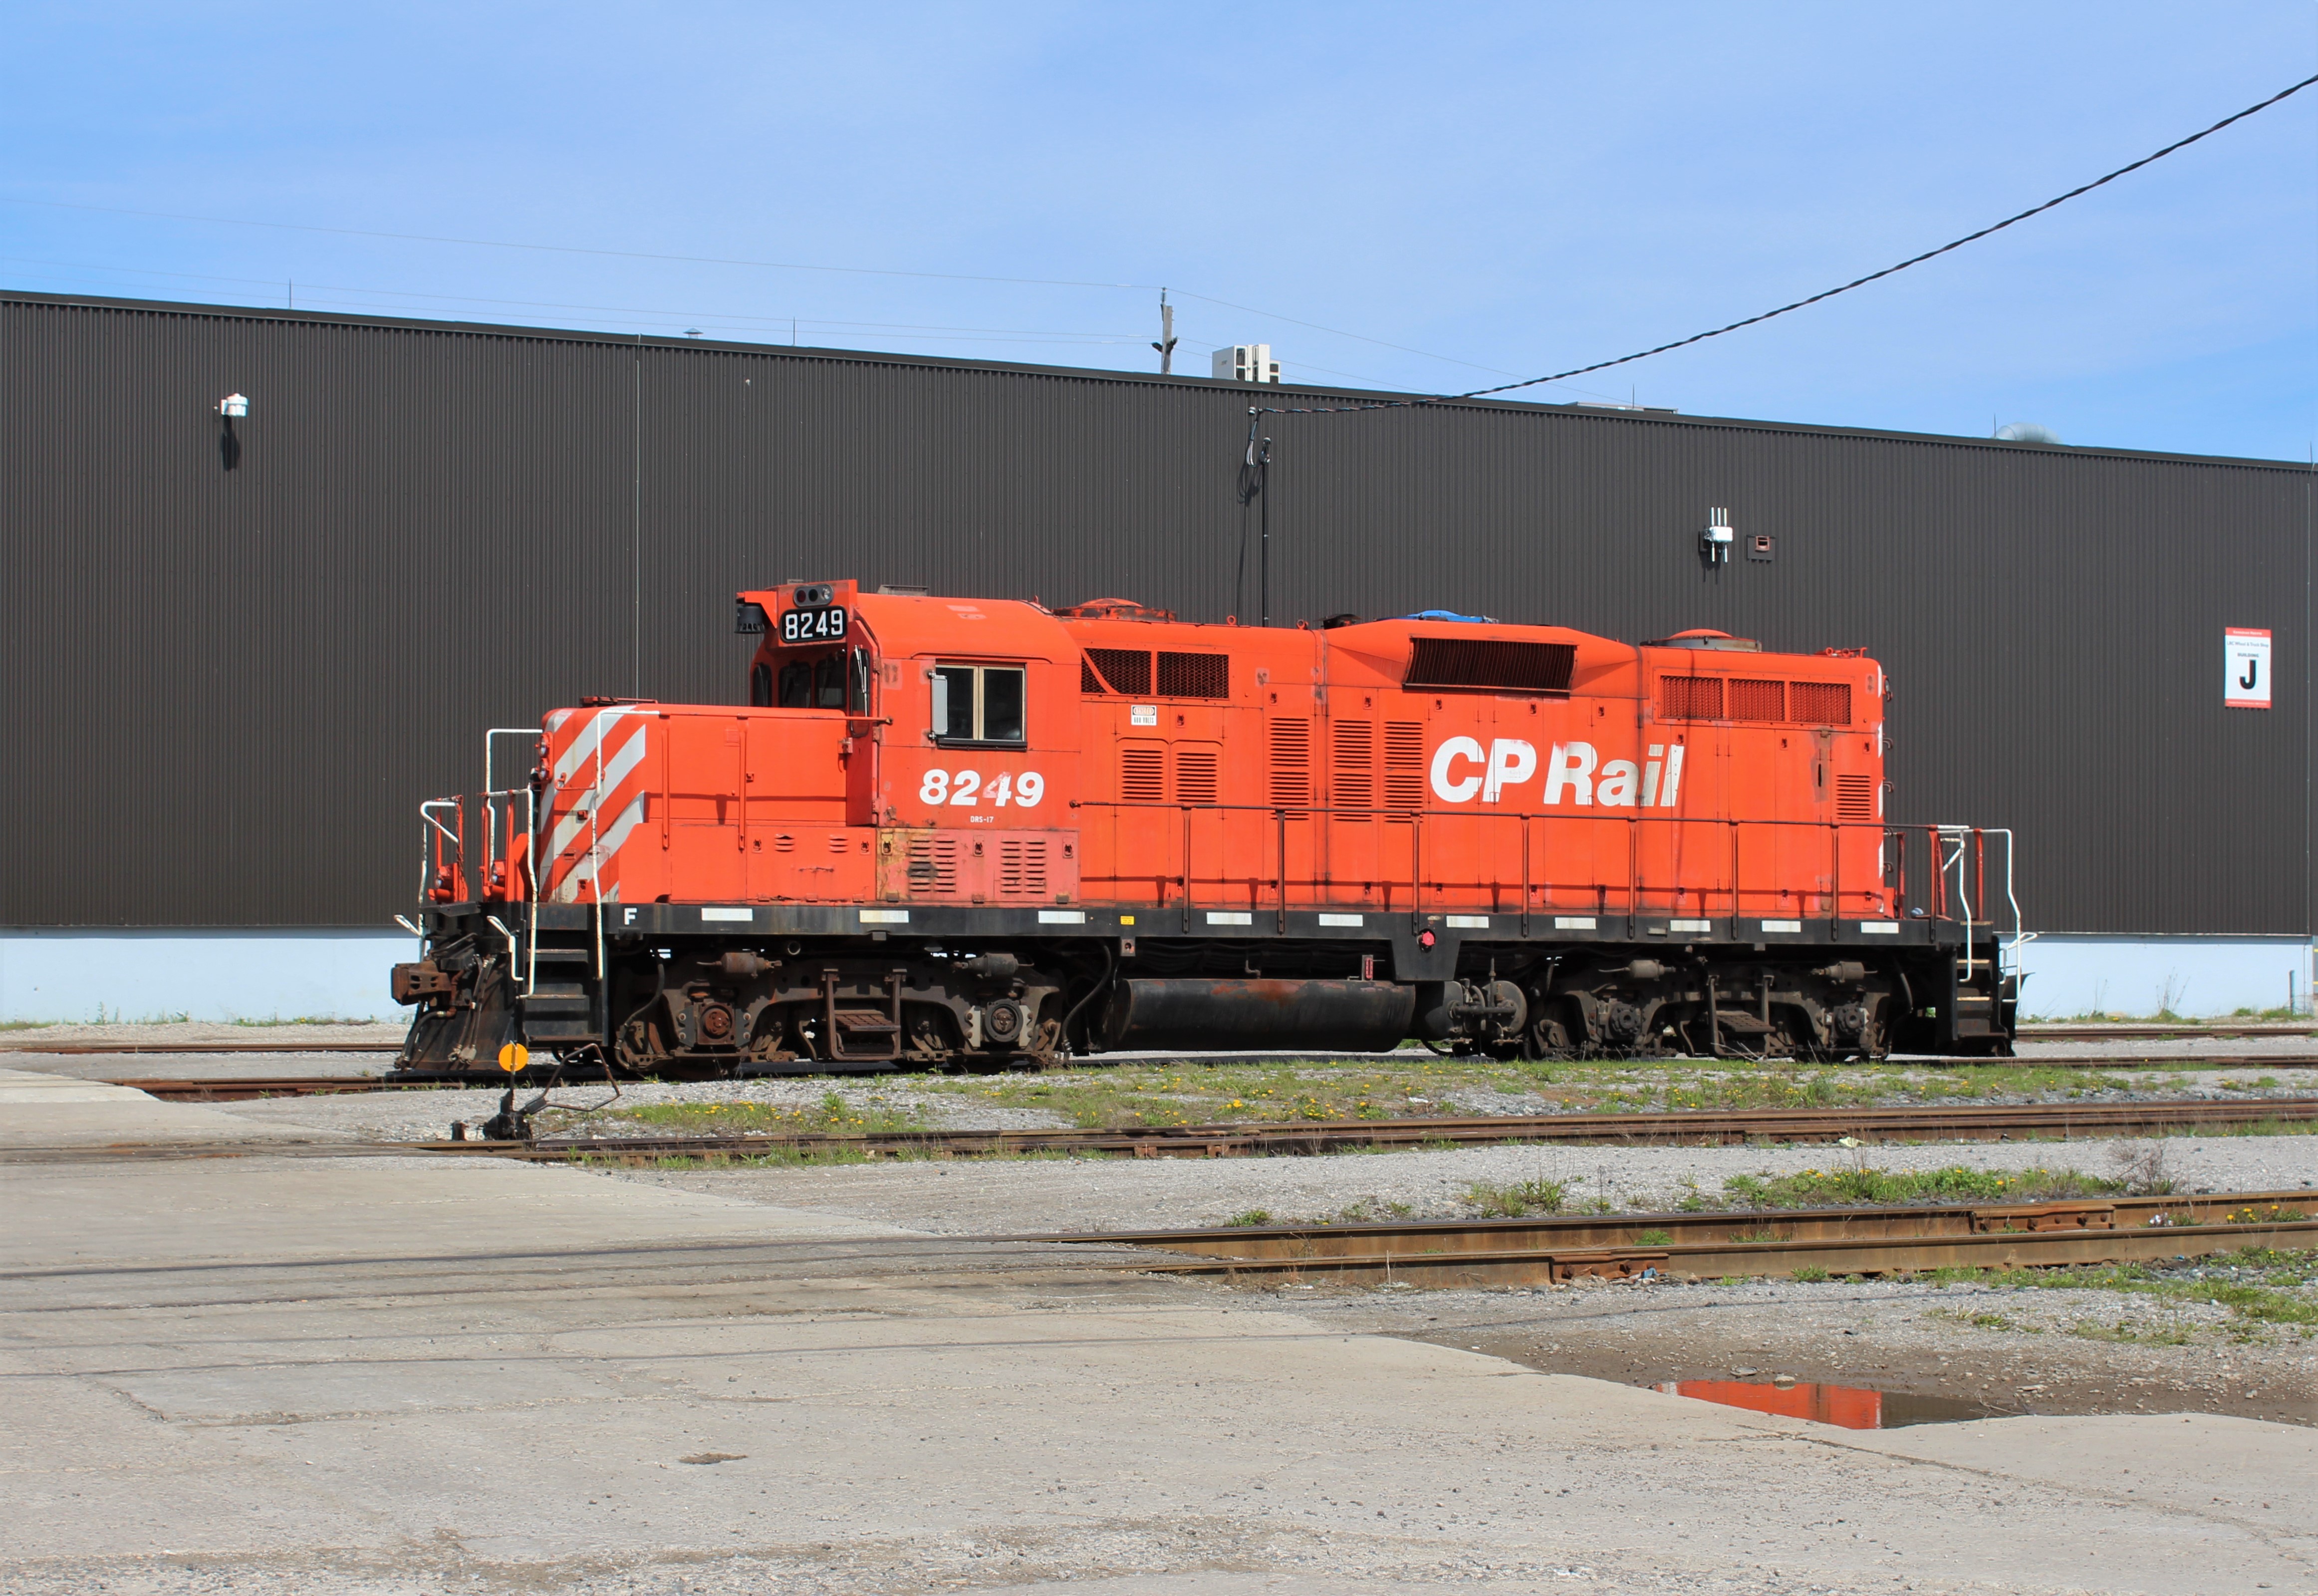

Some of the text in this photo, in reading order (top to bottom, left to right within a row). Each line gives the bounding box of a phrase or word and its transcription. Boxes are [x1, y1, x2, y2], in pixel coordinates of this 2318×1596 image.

[785, 609, 843, 639] 8249
[2239, 659, 2256, 690] J
[1430, 736, 1684, 807] CP Rail
[919, 769, 1044, 807] 8249
[624, 907, 637, 925] F
